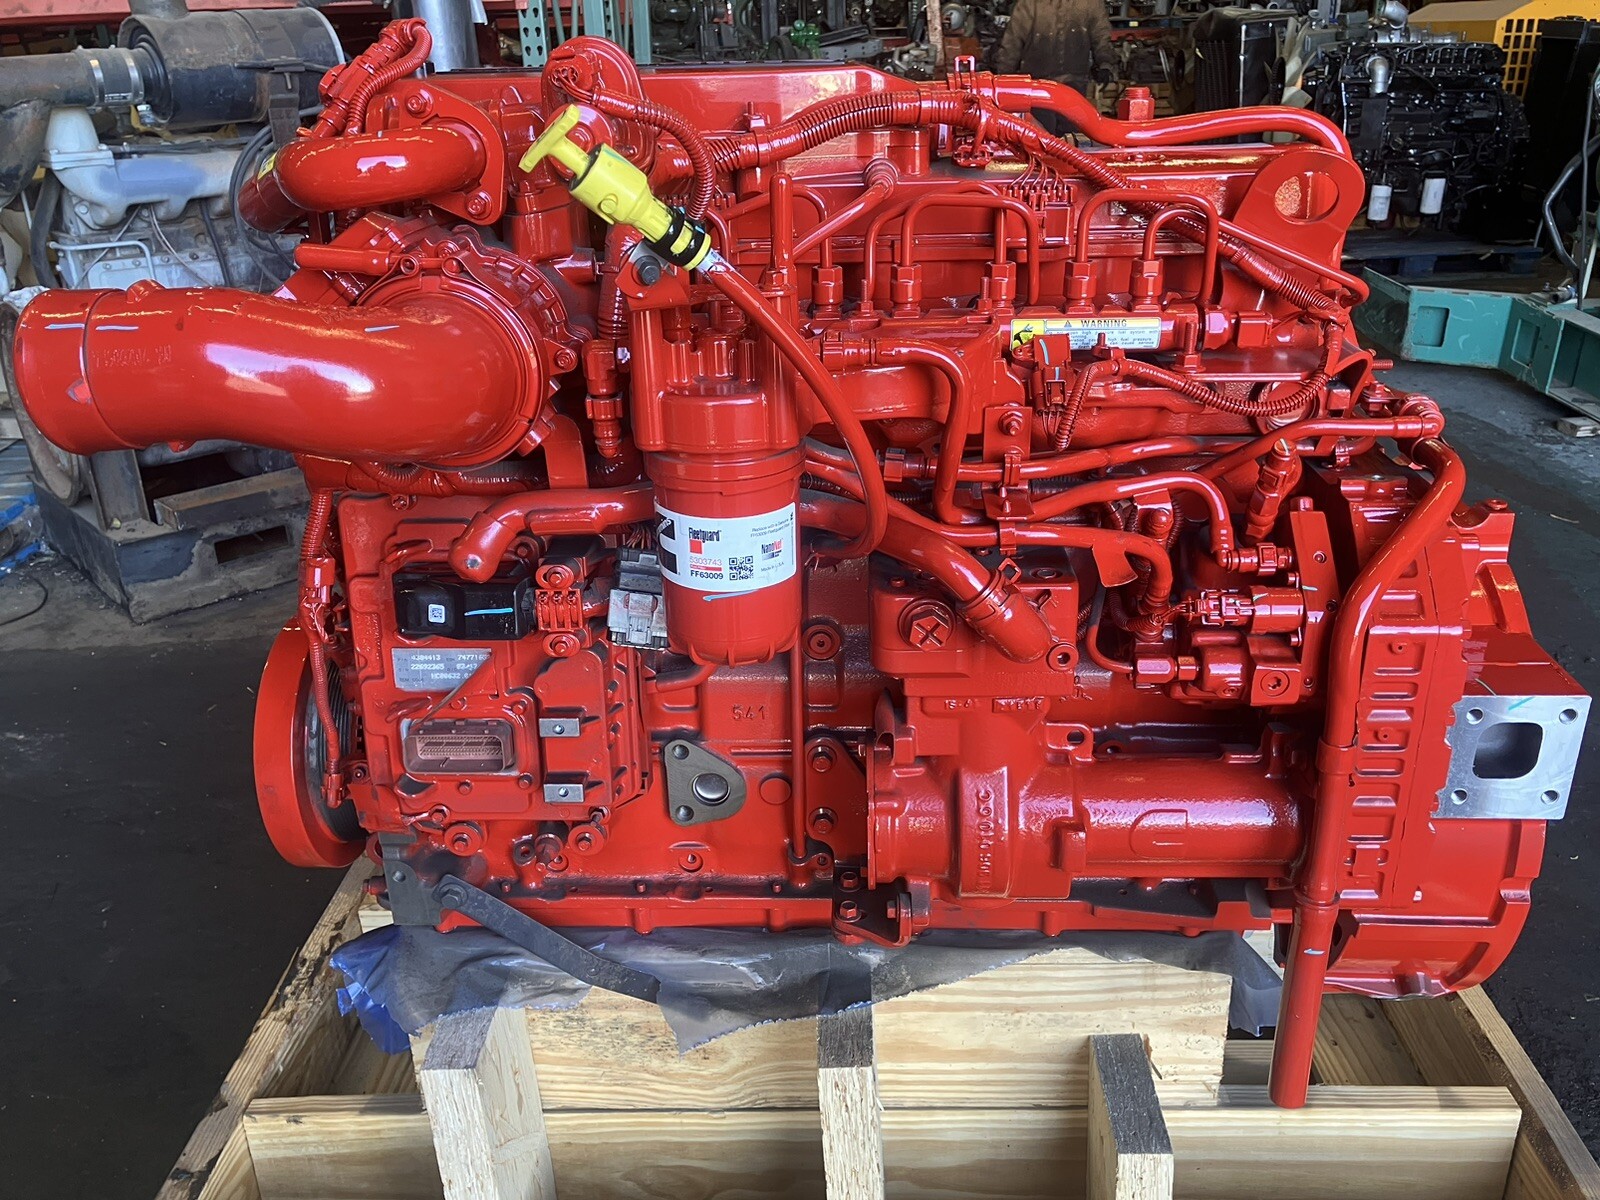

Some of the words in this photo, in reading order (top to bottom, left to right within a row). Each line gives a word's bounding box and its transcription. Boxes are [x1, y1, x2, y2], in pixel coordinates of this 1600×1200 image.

[1081, 319, 1127, 328] WARNING
[688, 526, 720, 543] Fleetguard
[689, 556, 722, 567] 5303743
[690, 569, 724, 580] FF63009
